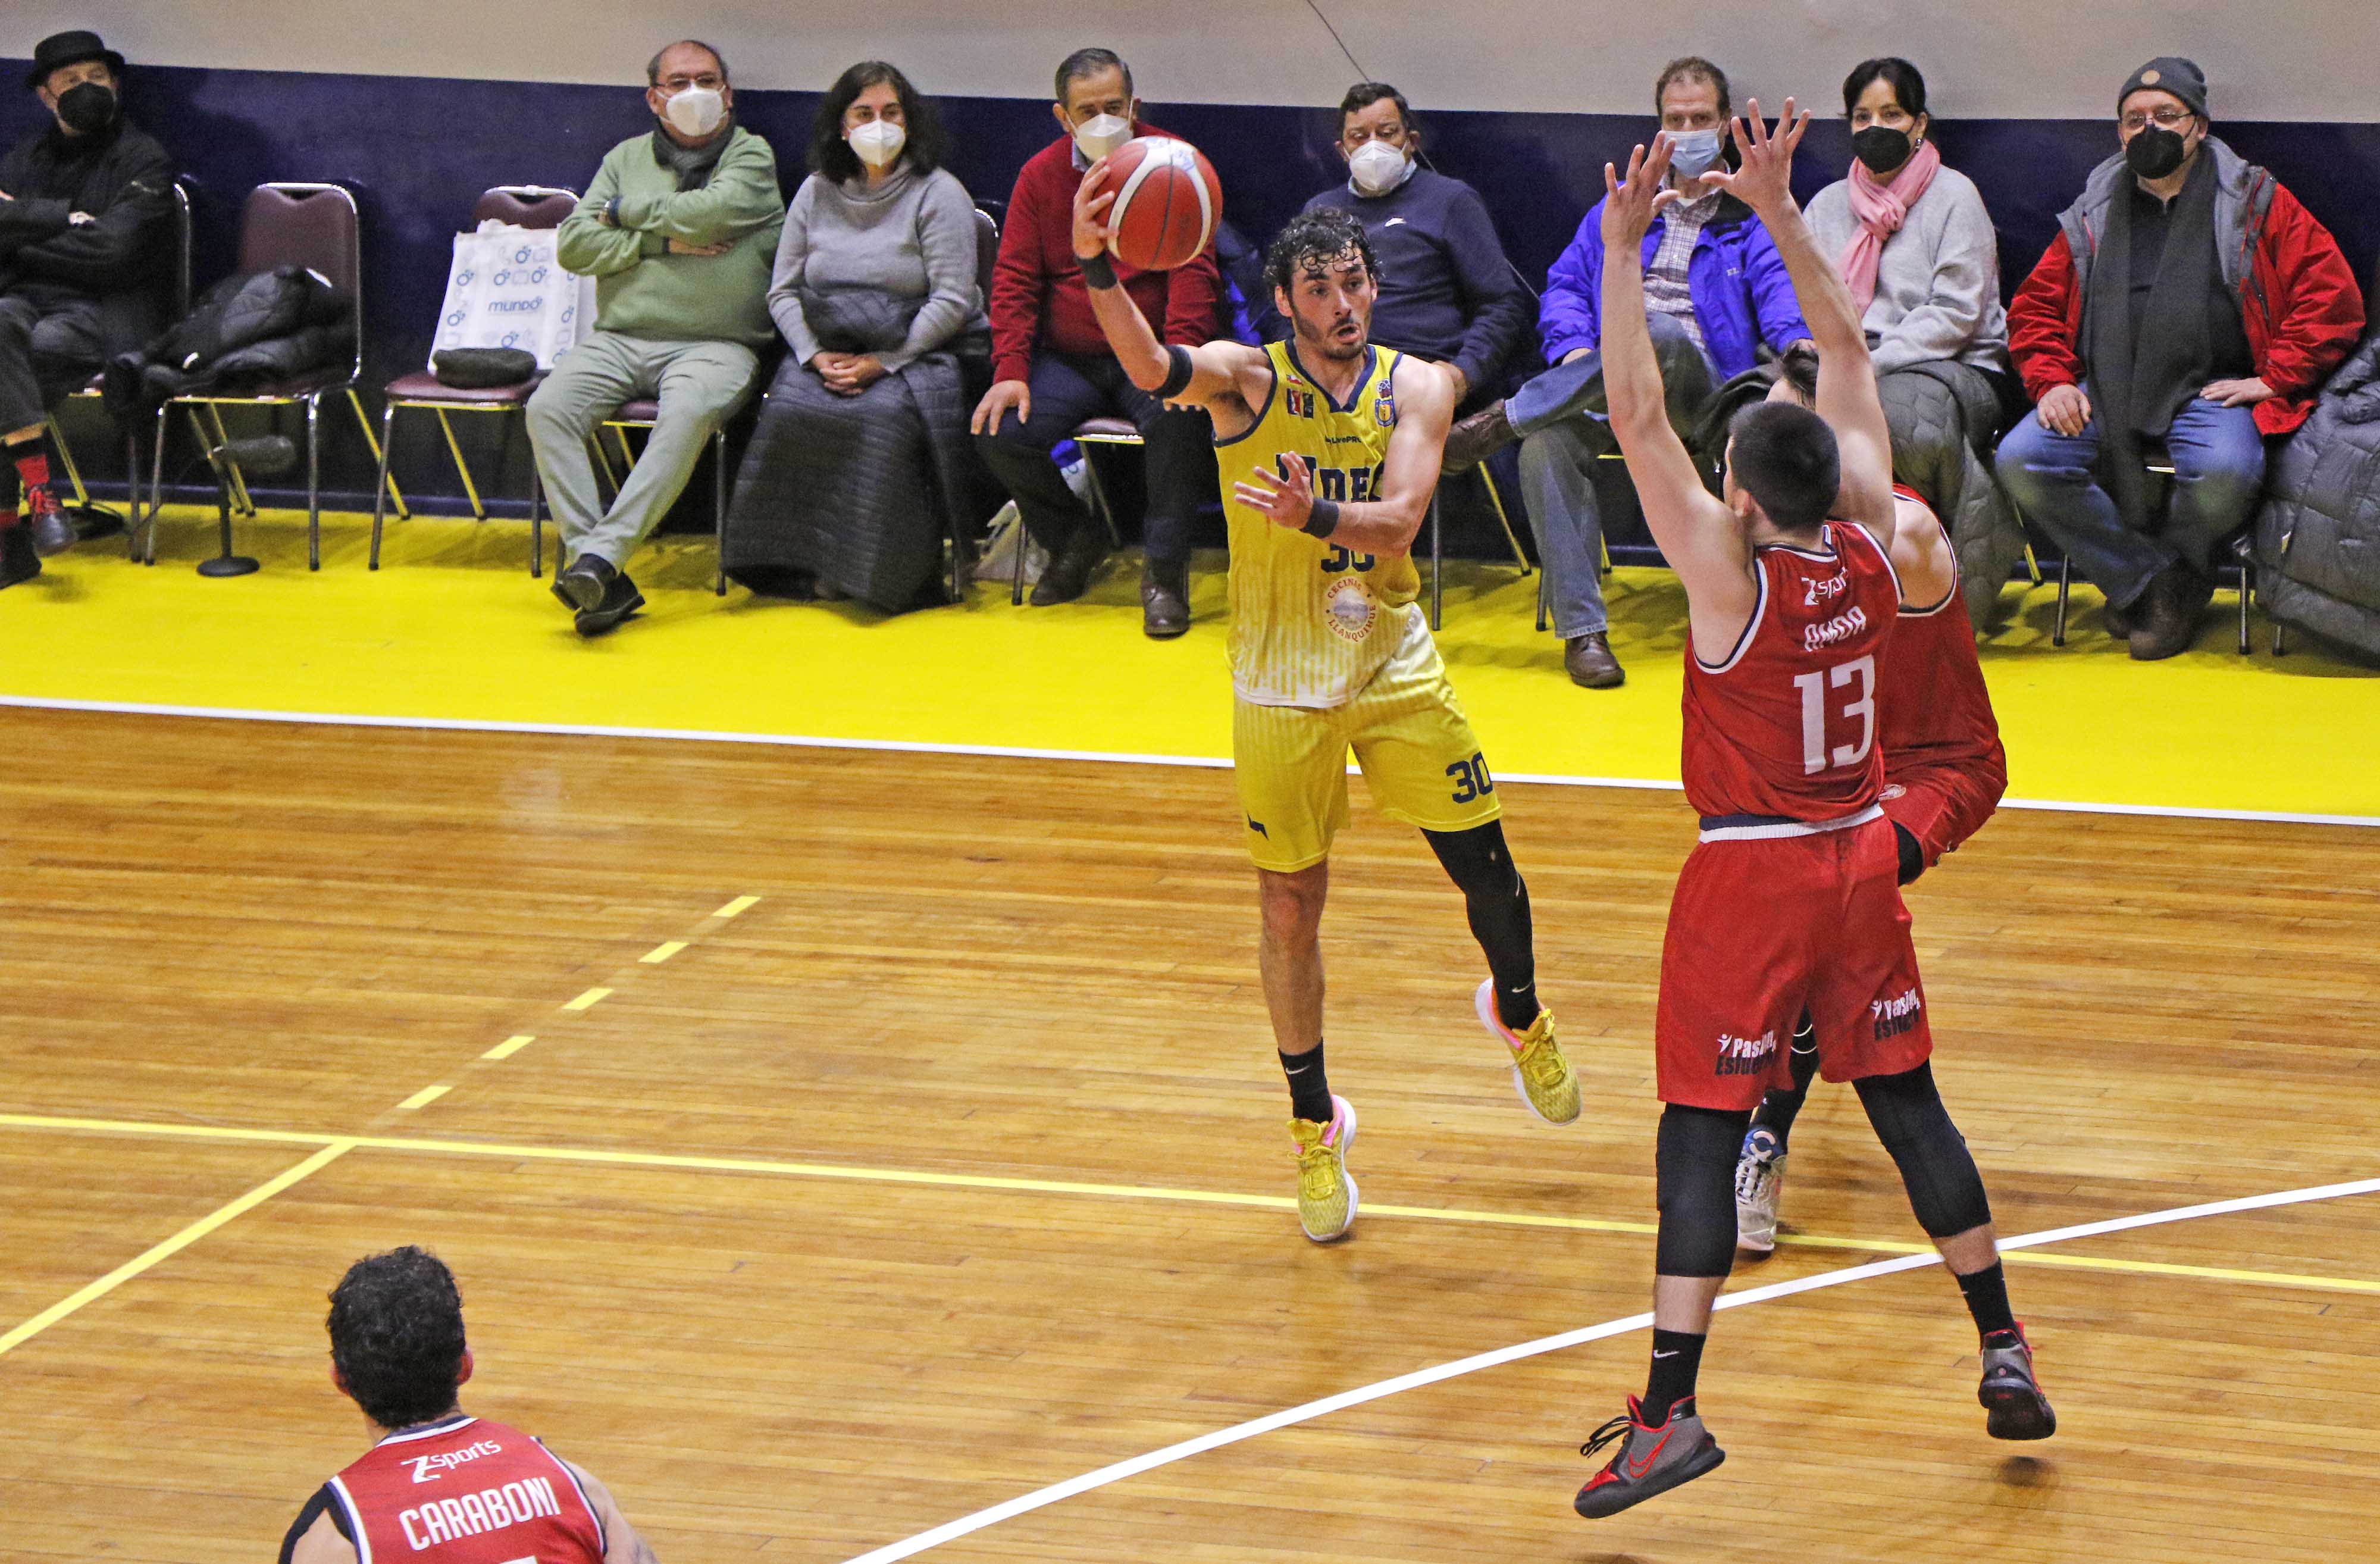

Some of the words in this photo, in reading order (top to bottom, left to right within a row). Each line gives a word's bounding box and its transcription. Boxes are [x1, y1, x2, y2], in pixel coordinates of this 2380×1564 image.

[1794, 655, 1875, 775] 13
[1445, 751, 1493, 803] 30
[399, 1477, 561, 1551] CARABONI
